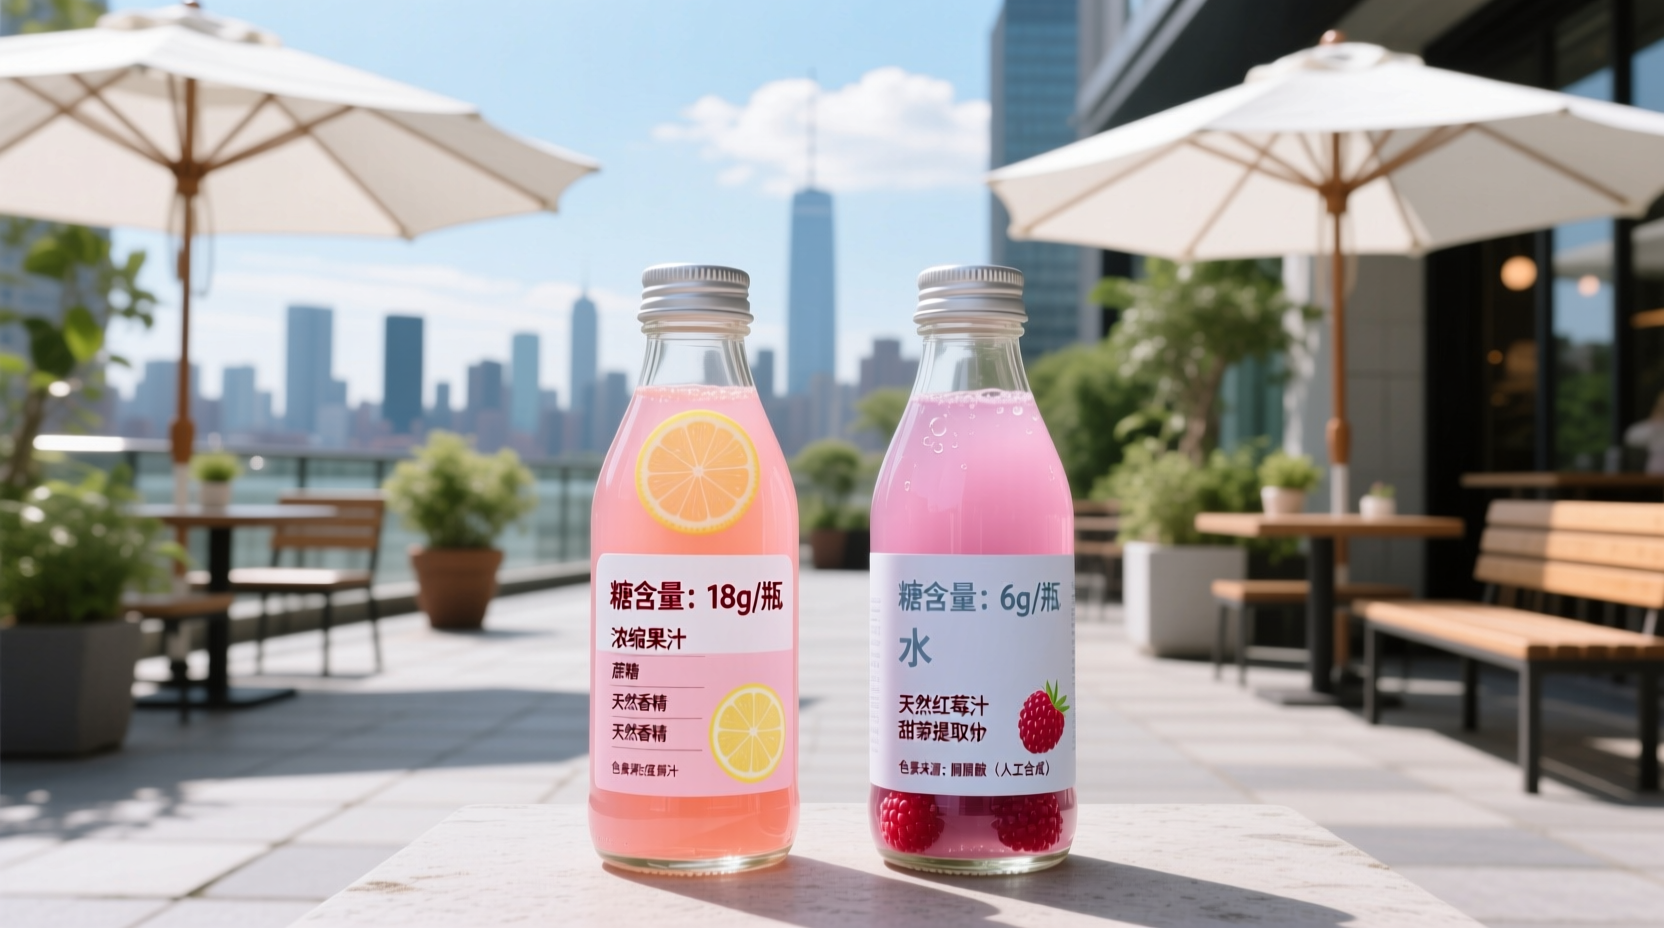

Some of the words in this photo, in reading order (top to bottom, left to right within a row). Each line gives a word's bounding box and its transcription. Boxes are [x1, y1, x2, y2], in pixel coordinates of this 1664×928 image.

[611, 626, 686, 651] 浓缩果汁
[898, 627, 932, 668] 水
[612, 693, 668, 713] 天然香精
[898, 694, 990, 717] 天然红莓汁
[612, 723, 668, 743] 天然香精
